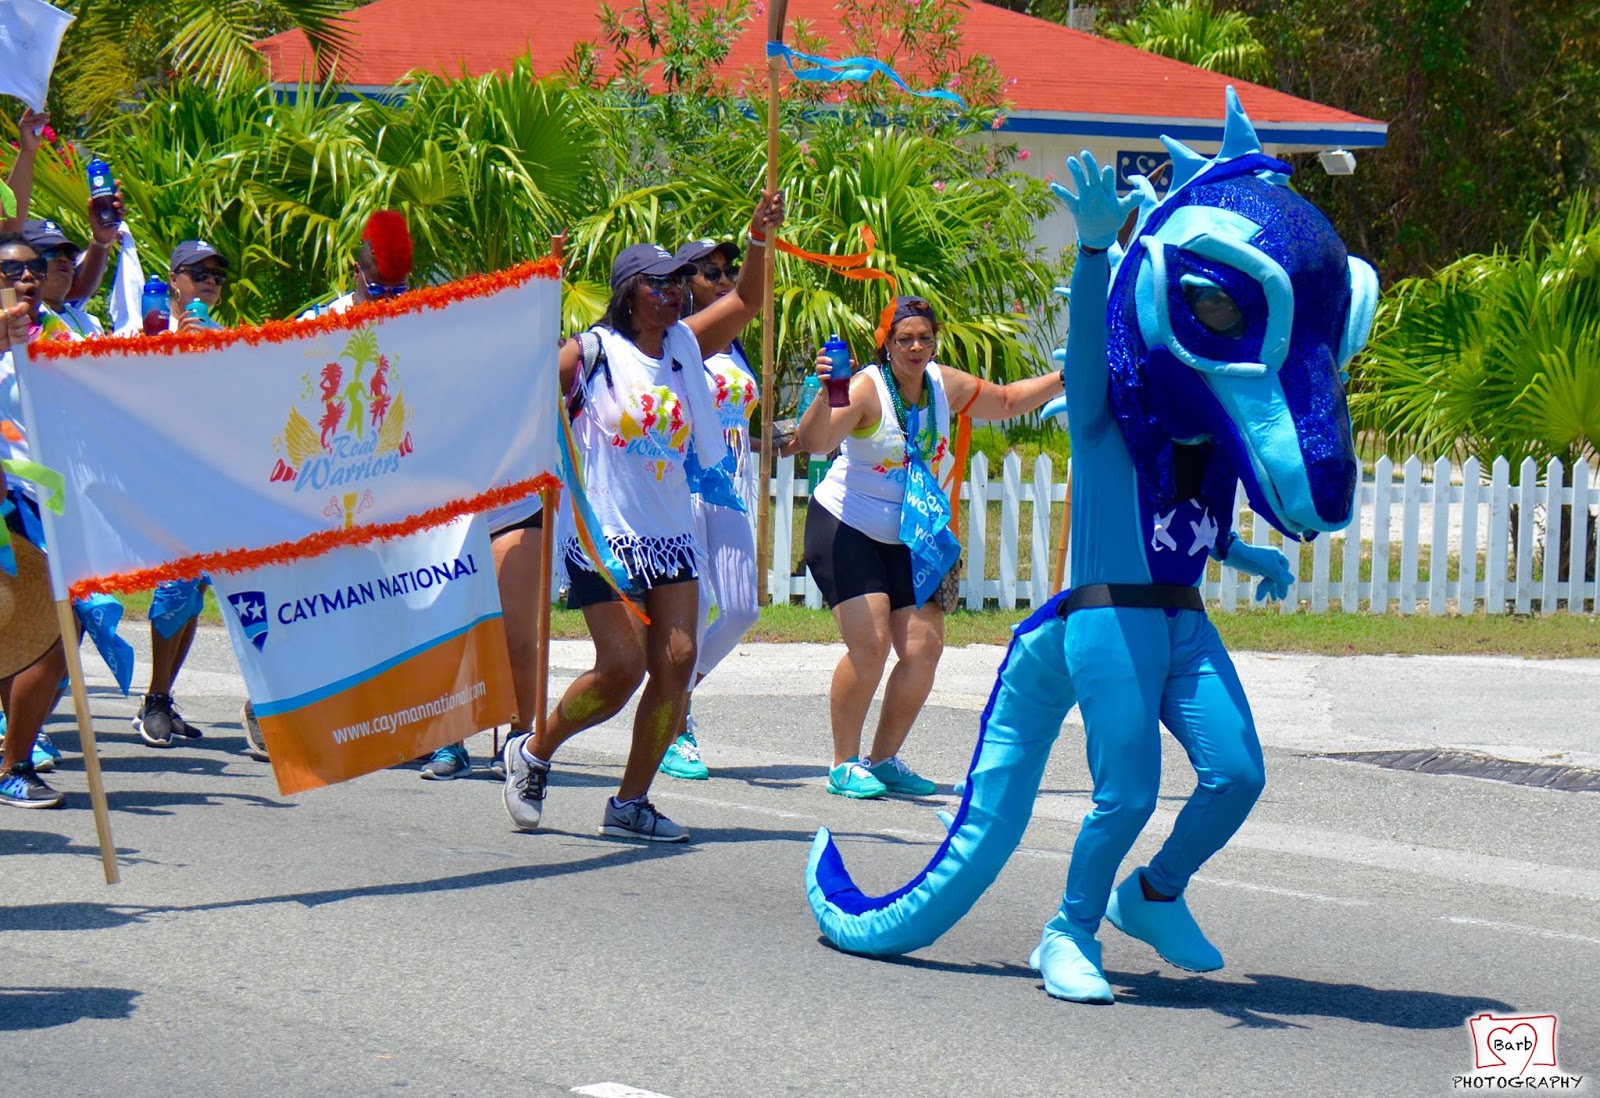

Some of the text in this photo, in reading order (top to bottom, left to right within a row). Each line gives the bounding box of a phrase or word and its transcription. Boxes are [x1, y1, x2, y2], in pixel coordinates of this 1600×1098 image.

[294, 453, 399, 492] Warriors
[331, 430, 378, 465] Road
[277, 554, 478, 625] CAYMAN NATIONAL
[332, 680, 486, 745] www.caymannational.com
